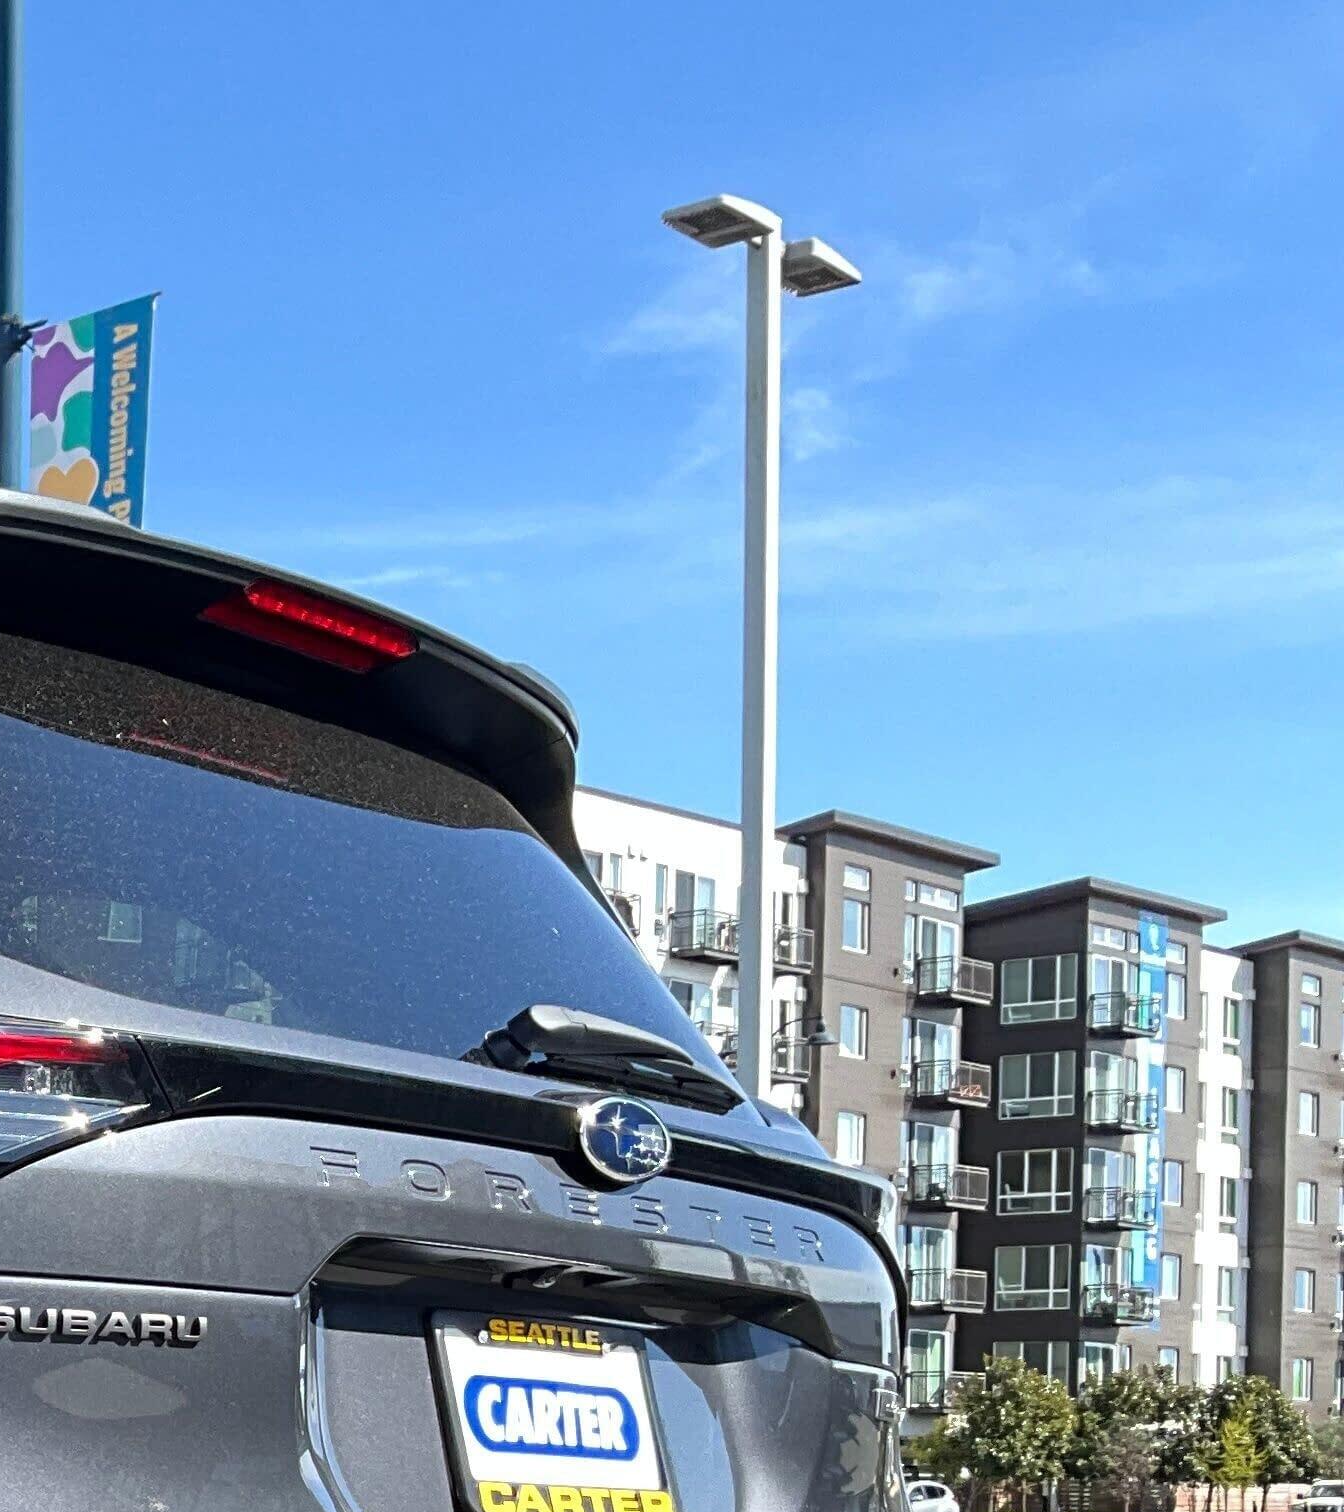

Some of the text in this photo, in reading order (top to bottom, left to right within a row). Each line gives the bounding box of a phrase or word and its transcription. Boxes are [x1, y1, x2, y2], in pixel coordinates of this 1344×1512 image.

[114, 323, 138, 344] A
[103, 343, 136, 498] Welcoming
[309, 1145, 824, 1263] FORESTER
[488, 1317, 603, 1351] SEATTLE
[476, 1382, 628, 1452] CARTER
